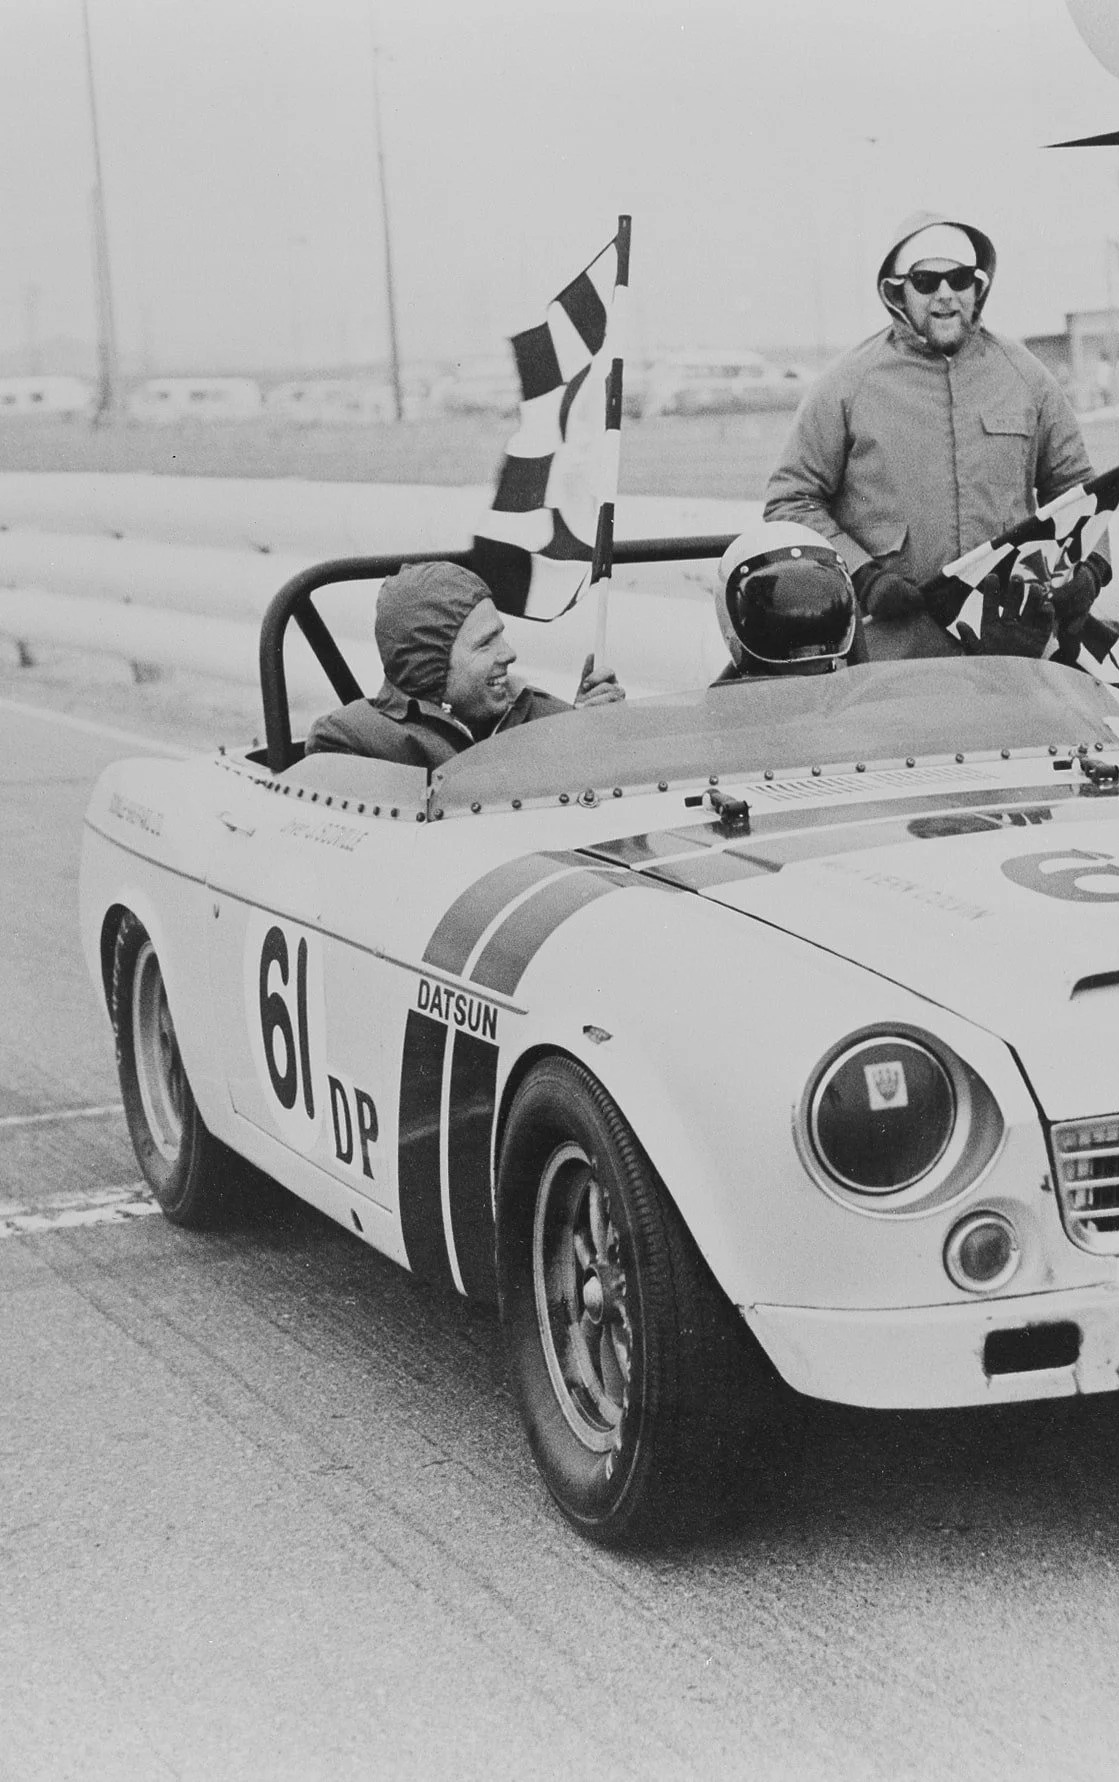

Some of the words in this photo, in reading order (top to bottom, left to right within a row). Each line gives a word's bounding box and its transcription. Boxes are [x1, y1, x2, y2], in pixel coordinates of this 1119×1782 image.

[260, 926, 315, 1120] 61
[417, 978, 498, 1040] DATSUN
[327, 1074, 379, 1180] DP
